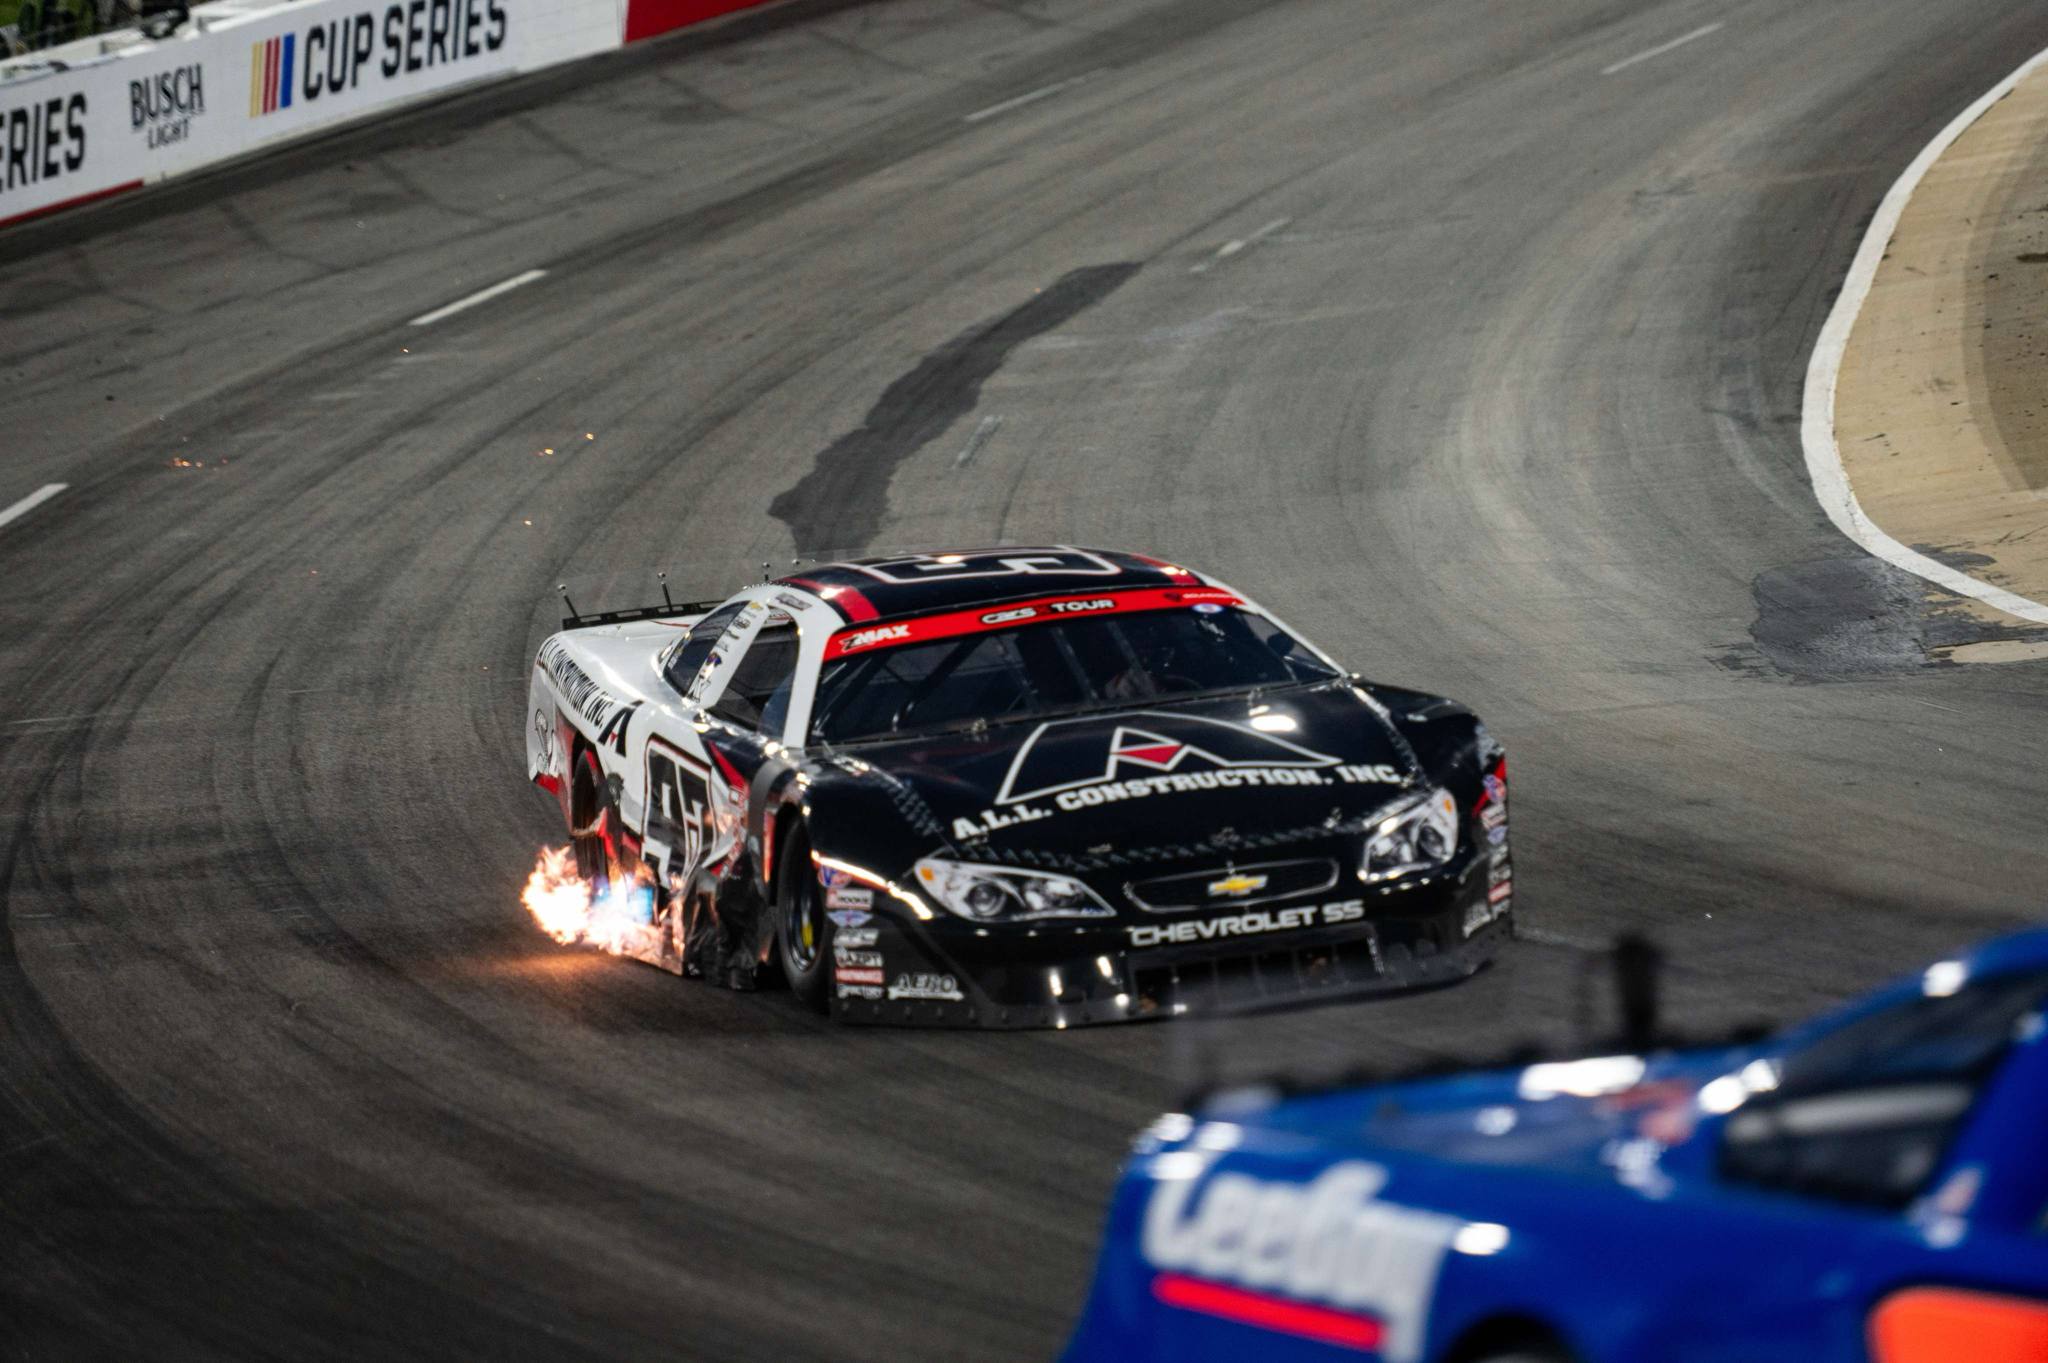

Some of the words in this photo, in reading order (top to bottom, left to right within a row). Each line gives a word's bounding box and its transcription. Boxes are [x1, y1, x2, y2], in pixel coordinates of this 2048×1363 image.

[303, 11, 374, 100] CUP
[381, 0, 506, 79] SERIES
[130, 62, 204, 130] BUSCH
[0, 91, 87, 194] RIES
[147, 117, 190, 149] LIGHT
[1050, 599, 1115, 613] TOUR
[952, 804, 1053, 840] A.L.L.
[1131, 906, 1317, 946] CHEVROLET
[1322, 900, 1365, 922] SS
